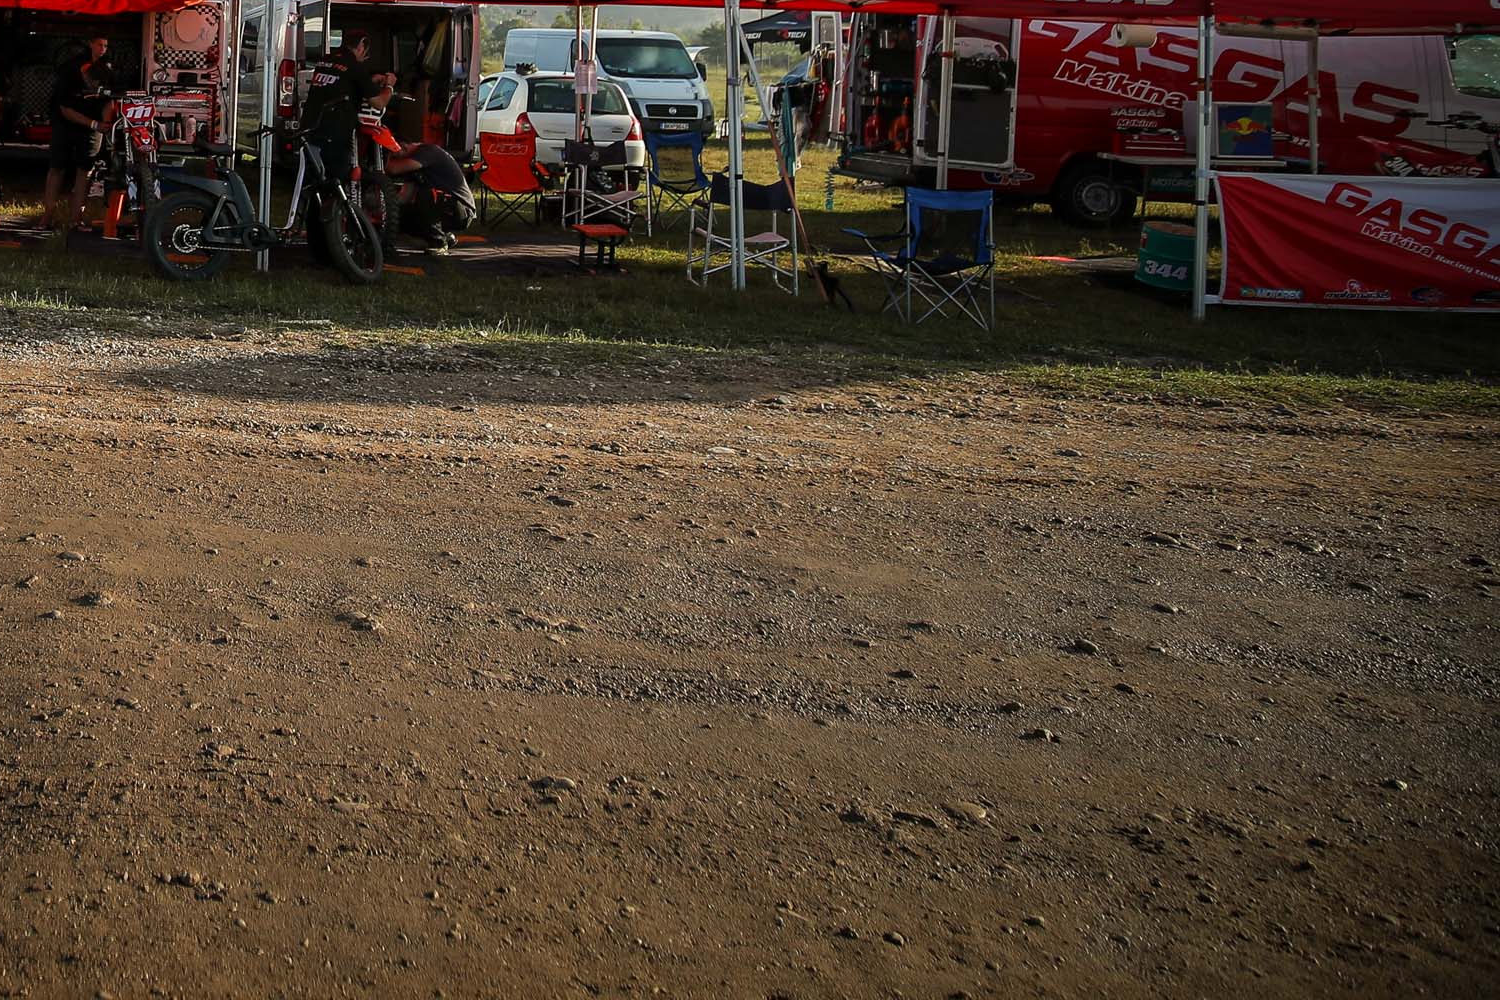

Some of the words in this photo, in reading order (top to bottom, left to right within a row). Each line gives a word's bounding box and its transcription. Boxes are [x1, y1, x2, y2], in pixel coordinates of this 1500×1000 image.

[126, 105, 153, 118] 111
[1143, 259, 1189, 281] 344
[1436, 255, 1474, 274] Racing
